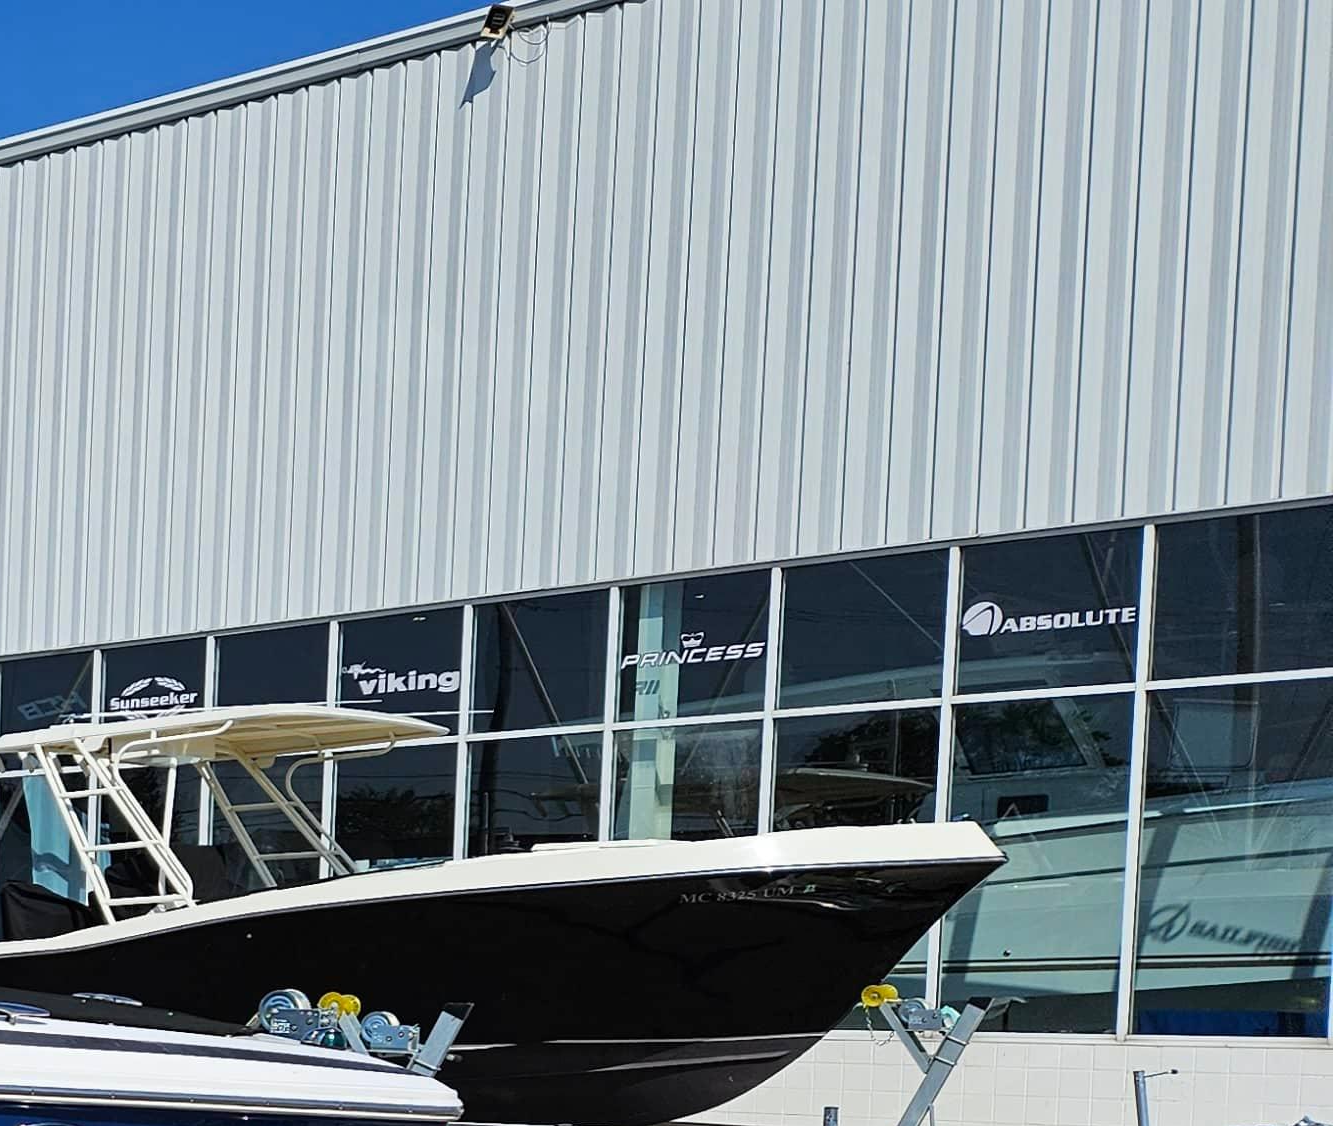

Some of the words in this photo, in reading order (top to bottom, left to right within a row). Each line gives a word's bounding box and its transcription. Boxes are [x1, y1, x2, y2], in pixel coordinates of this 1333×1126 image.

[1000, 607, 1136, 634] ABSOLUTE
[621, 641, 766, 670] PRINCESS
[358, 669, 461, 696] viking
[109, 691, 198, 711] Sunseeker
[680, 893, 712, 903] MC
